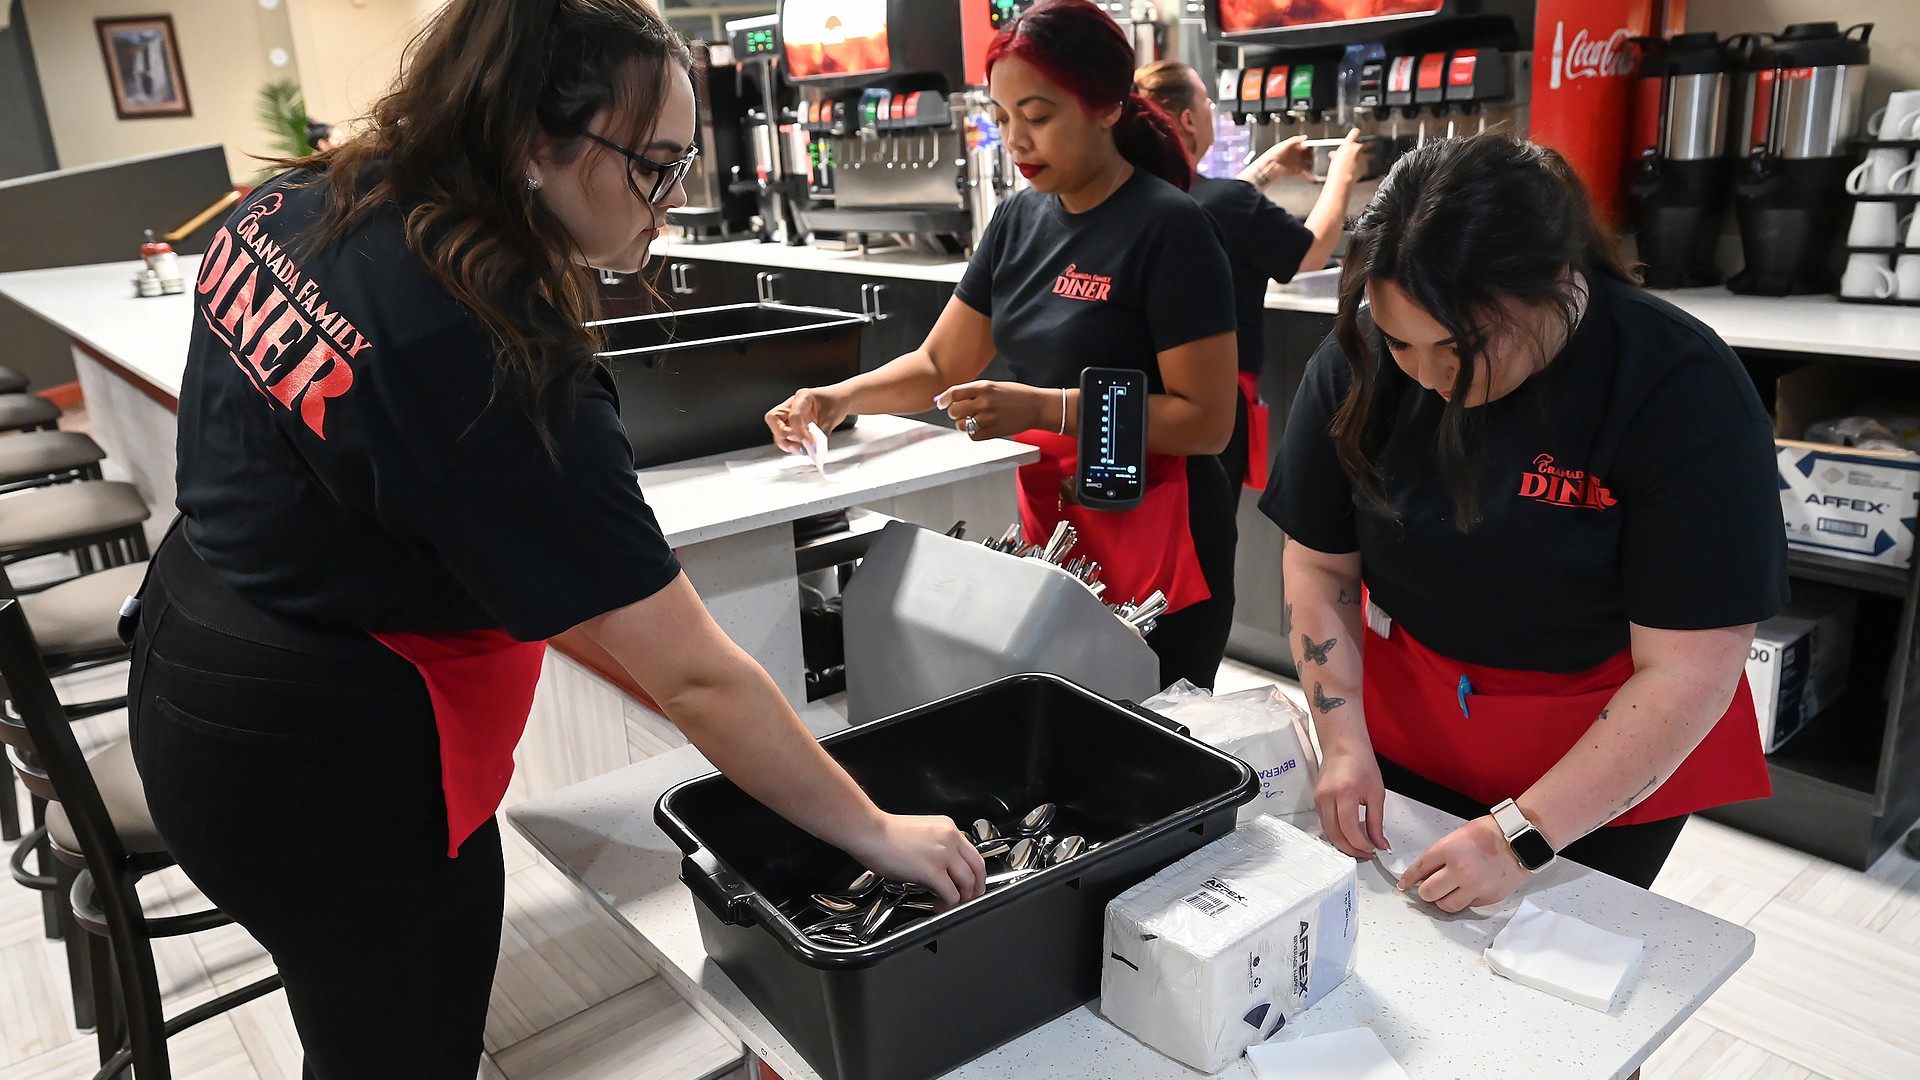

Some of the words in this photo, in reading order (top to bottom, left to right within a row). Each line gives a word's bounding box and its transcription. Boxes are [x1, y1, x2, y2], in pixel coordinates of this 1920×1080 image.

[237, 213, 302, 295] GRANADA
[295, 278, 373, 359] FAMILY
[1052, 276, 1111, 302] DINER
[197, 226, 354, 440] DINER
[1538, 461, 1585, 479] GRANAD
[1805, 494, 1884, 515] AFFEX
[1258, 759, 1296, 780] BEVERA
[1299, 920, 1309, 998] AFFEX
